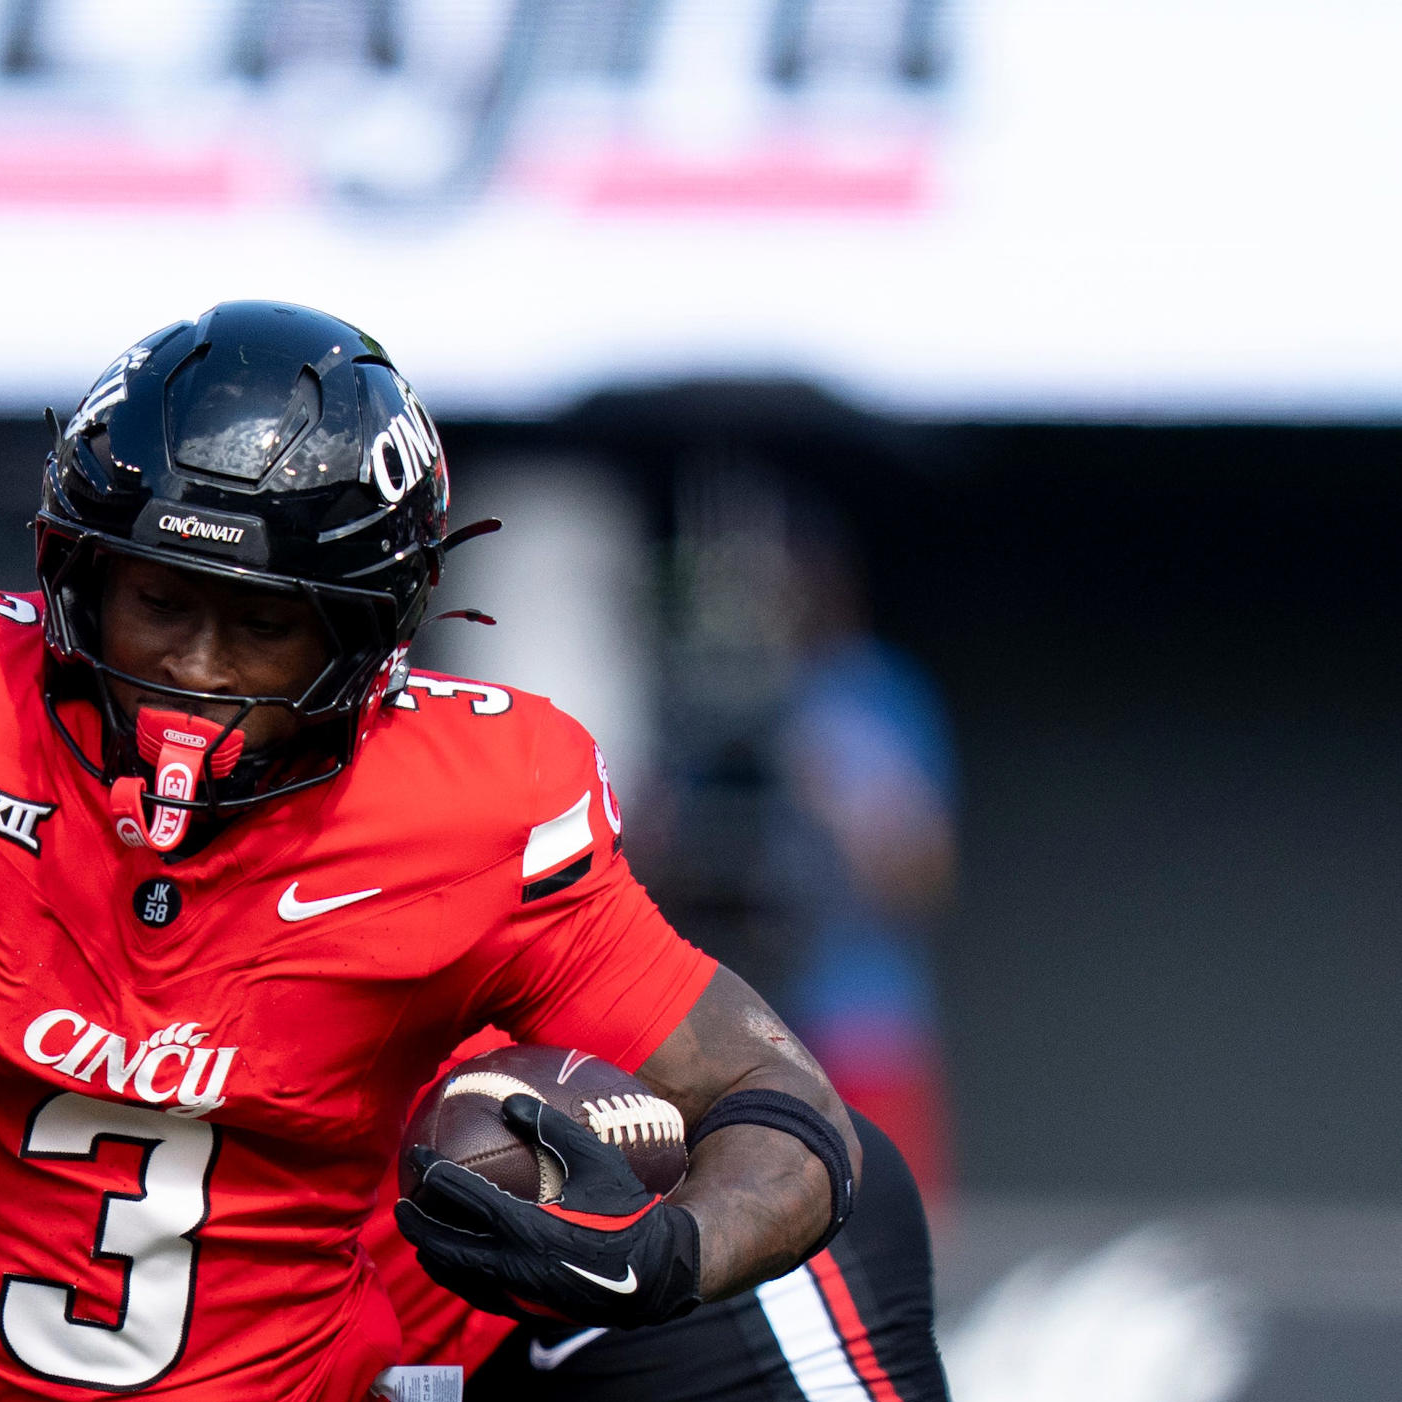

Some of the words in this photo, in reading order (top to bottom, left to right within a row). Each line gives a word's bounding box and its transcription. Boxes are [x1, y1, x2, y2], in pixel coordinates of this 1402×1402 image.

[370, 388, 450, 504] CINC
[158, 513, 245, 545] CINCINNATI
[147, 883, 170, 903] JK
[143, 903, 169, 923] 58
[22, 1008, 239, 1118] CINCY
